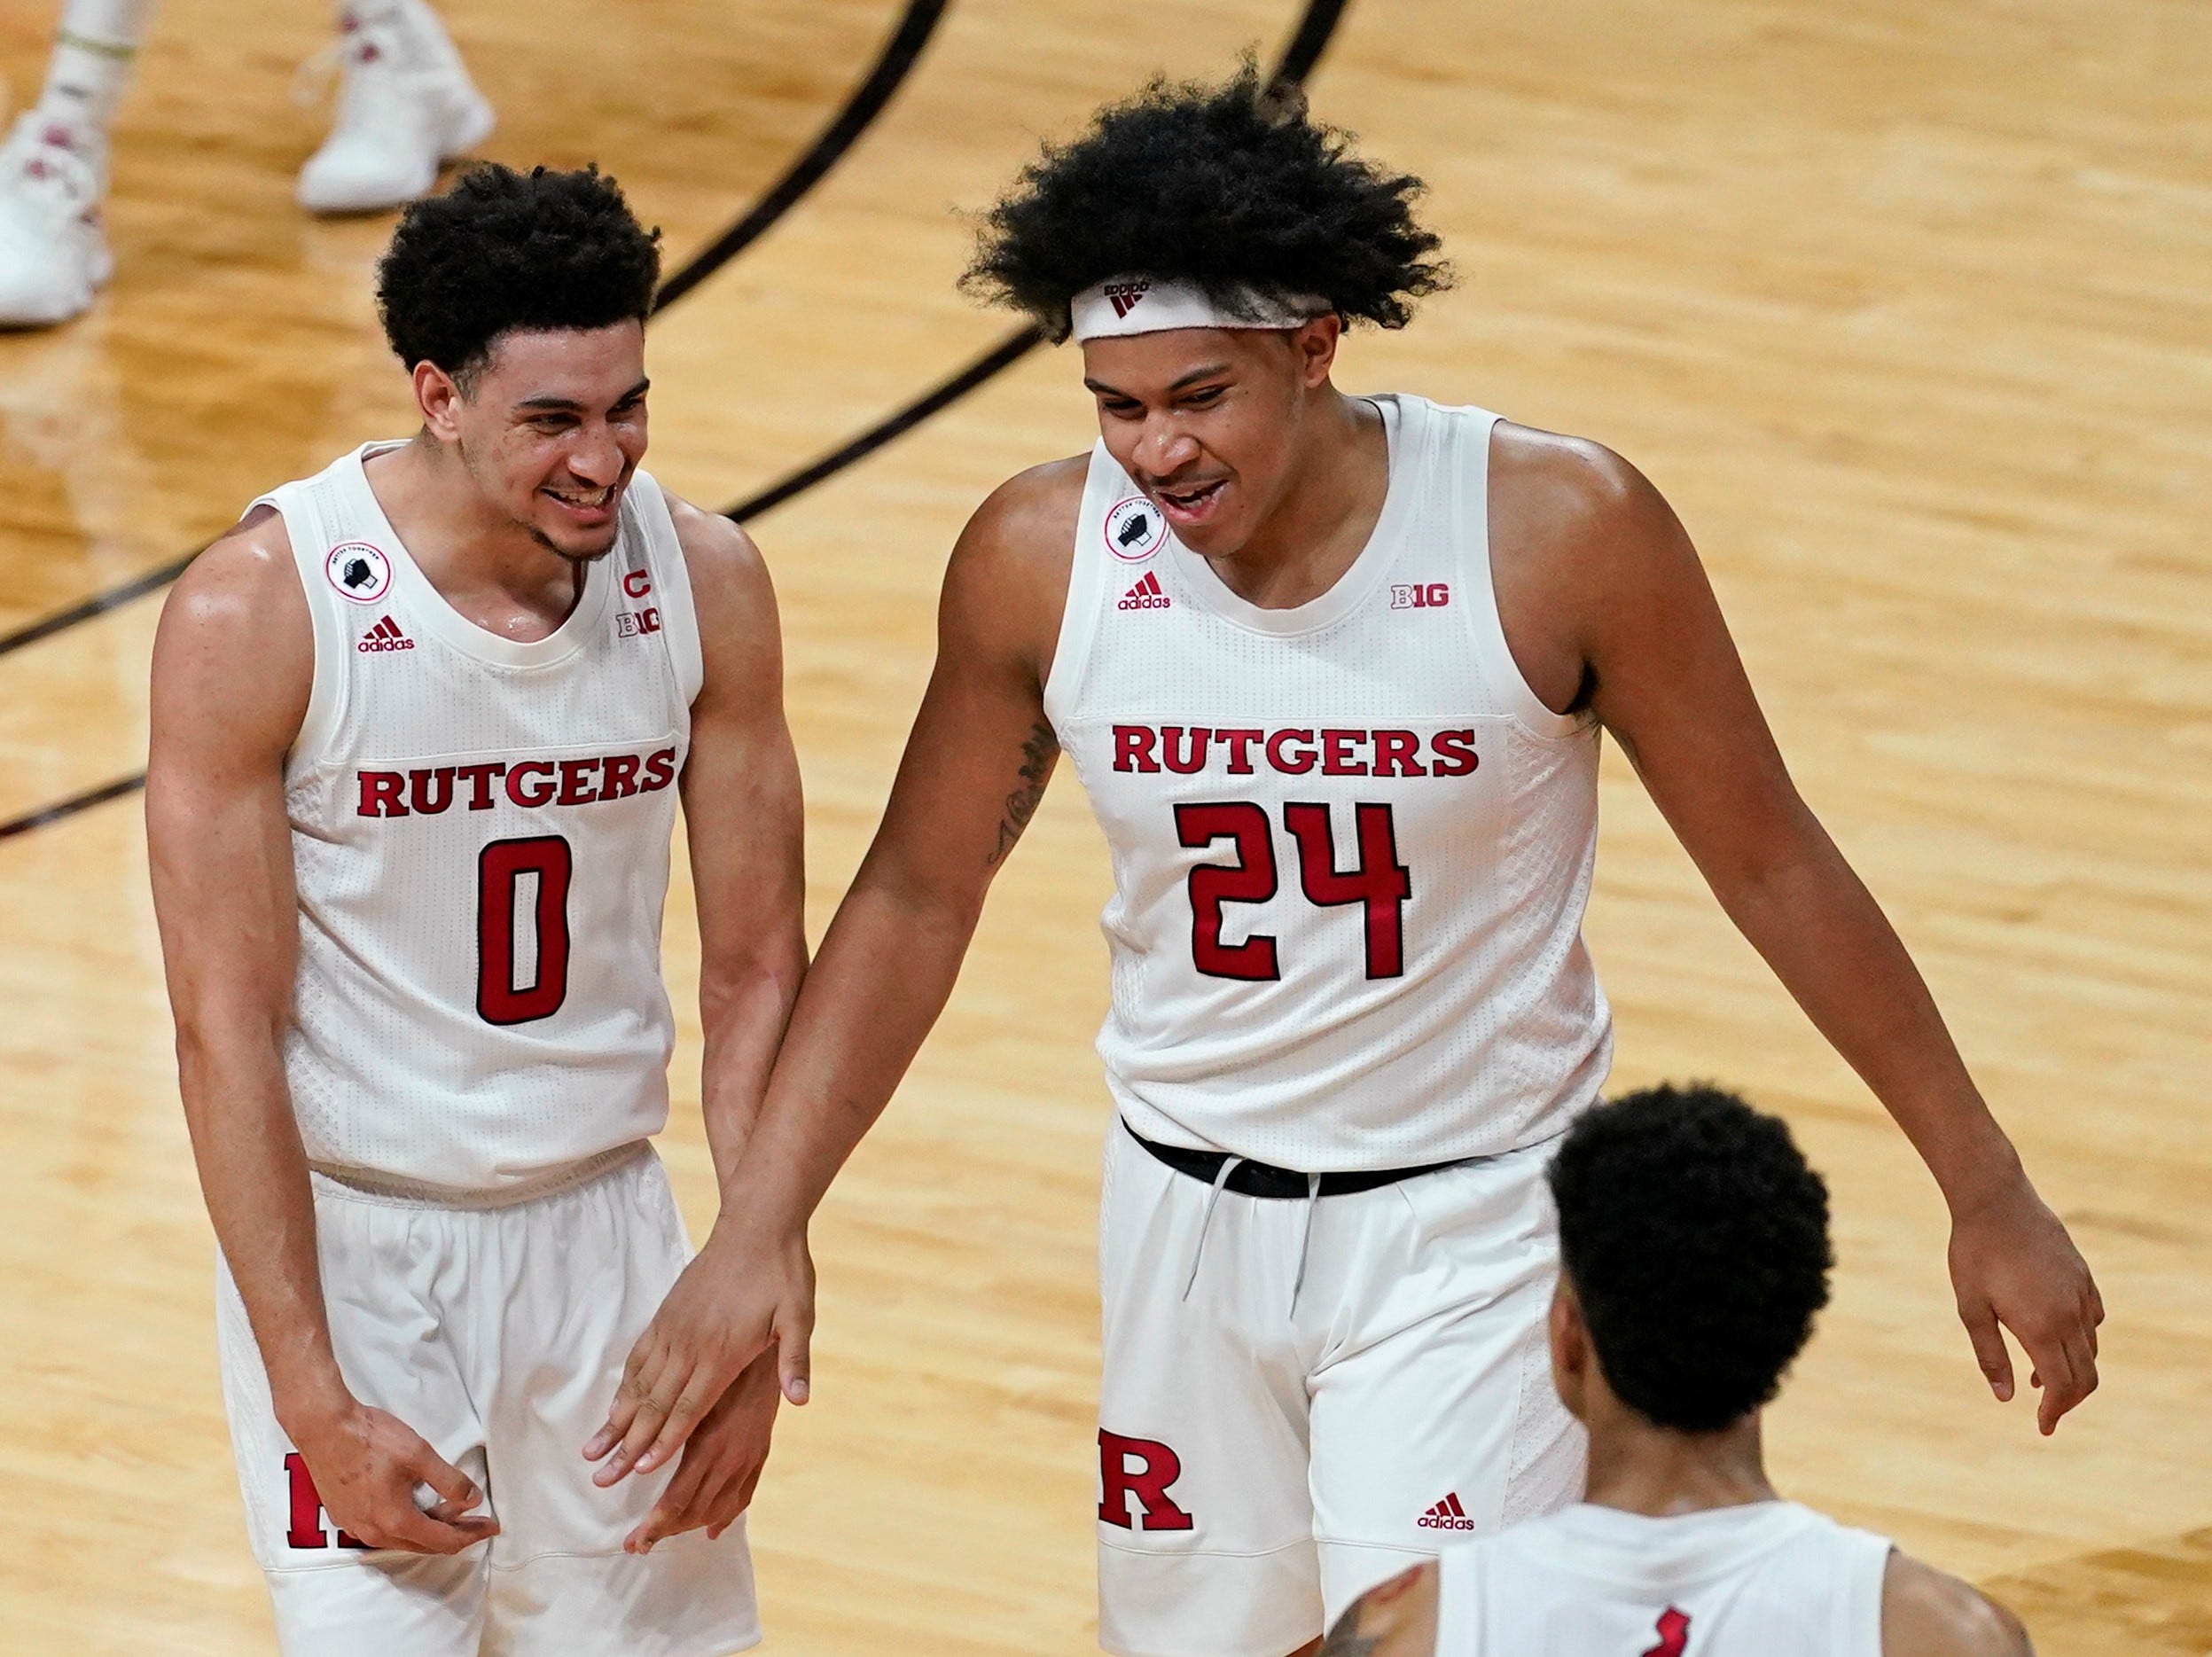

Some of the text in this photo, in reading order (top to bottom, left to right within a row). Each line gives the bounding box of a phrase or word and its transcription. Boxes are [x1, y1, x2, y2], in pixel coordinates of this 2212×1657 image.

[623, 568, 651, 598] C
[1118, 595, 1170, 610] adidas
[358, 636, 415, 653] adidas
[1113, 724, 1480, 777] RUTGERS
[357, 746, 676, 817] RUTGERS
[1173, 801, 1411, 981] 24
[476, 834, 572, 1026] 0
[1098, 1426, 1193, 1530] R
[1418, 1515, 1474, 1530] adidas
